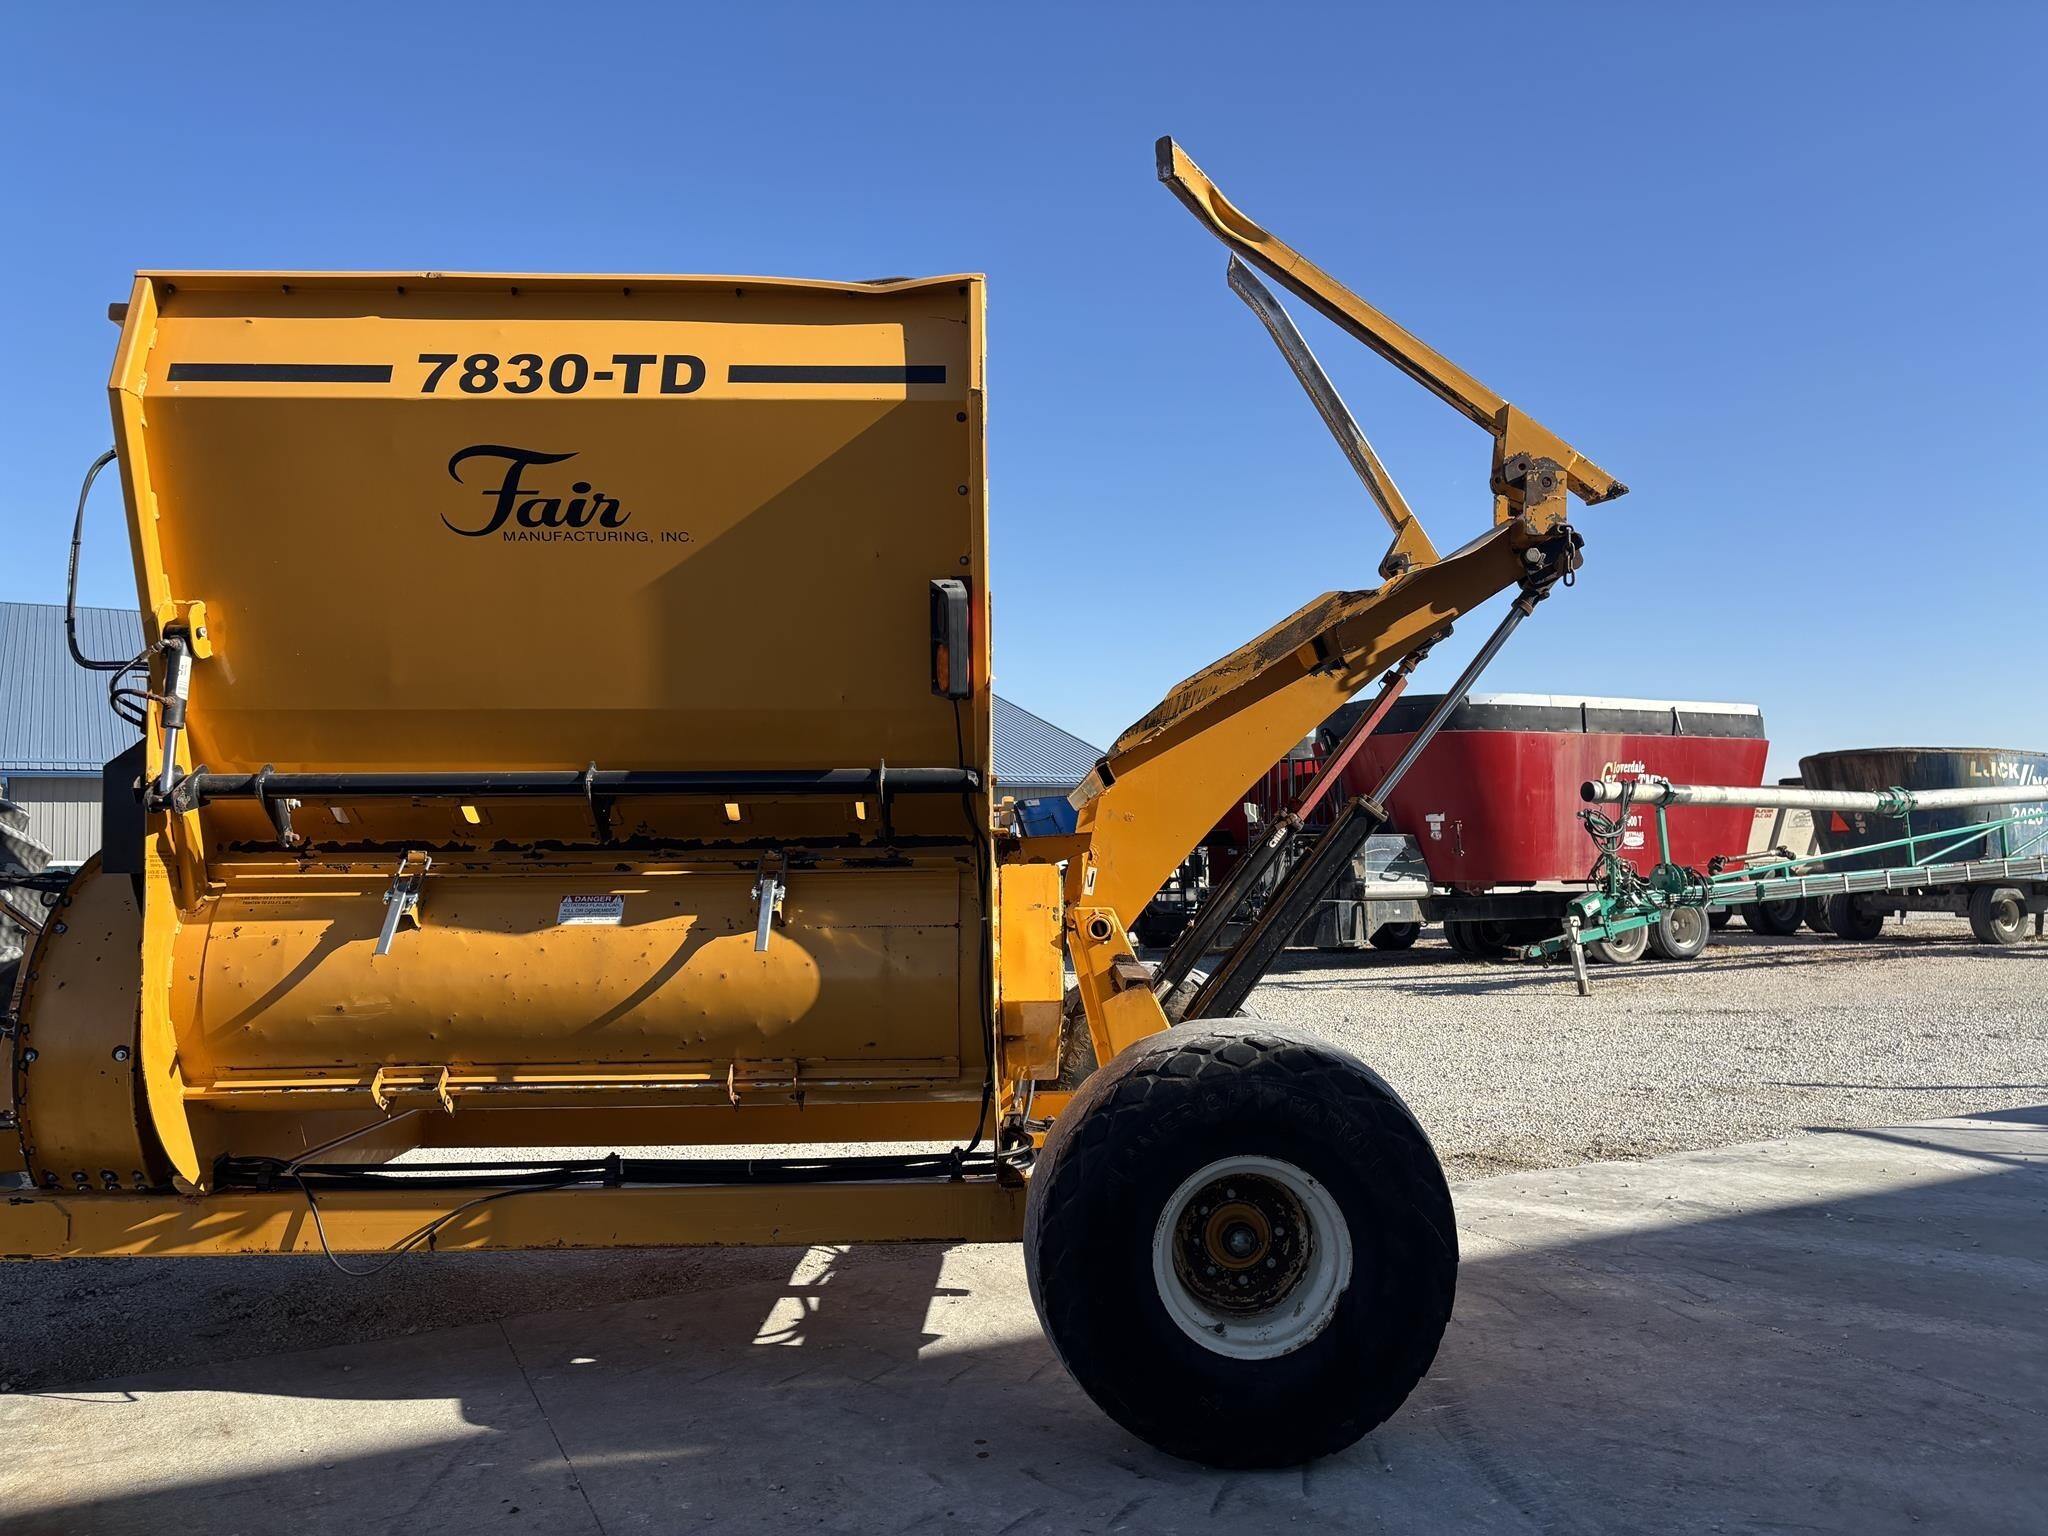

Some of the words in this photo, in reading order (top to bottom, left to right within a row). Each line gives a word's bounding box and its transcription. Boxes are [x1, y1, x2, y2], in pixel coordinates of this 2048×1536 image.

[417, 353, 707, 394] 7830-TD
[440, 444, 631, 537] Fair
[503, 531, 654, 544] MANUFACTURING,
[661, 531, 695, 543] INC.
[1601, 761, 1645, 783] Cloverdale
